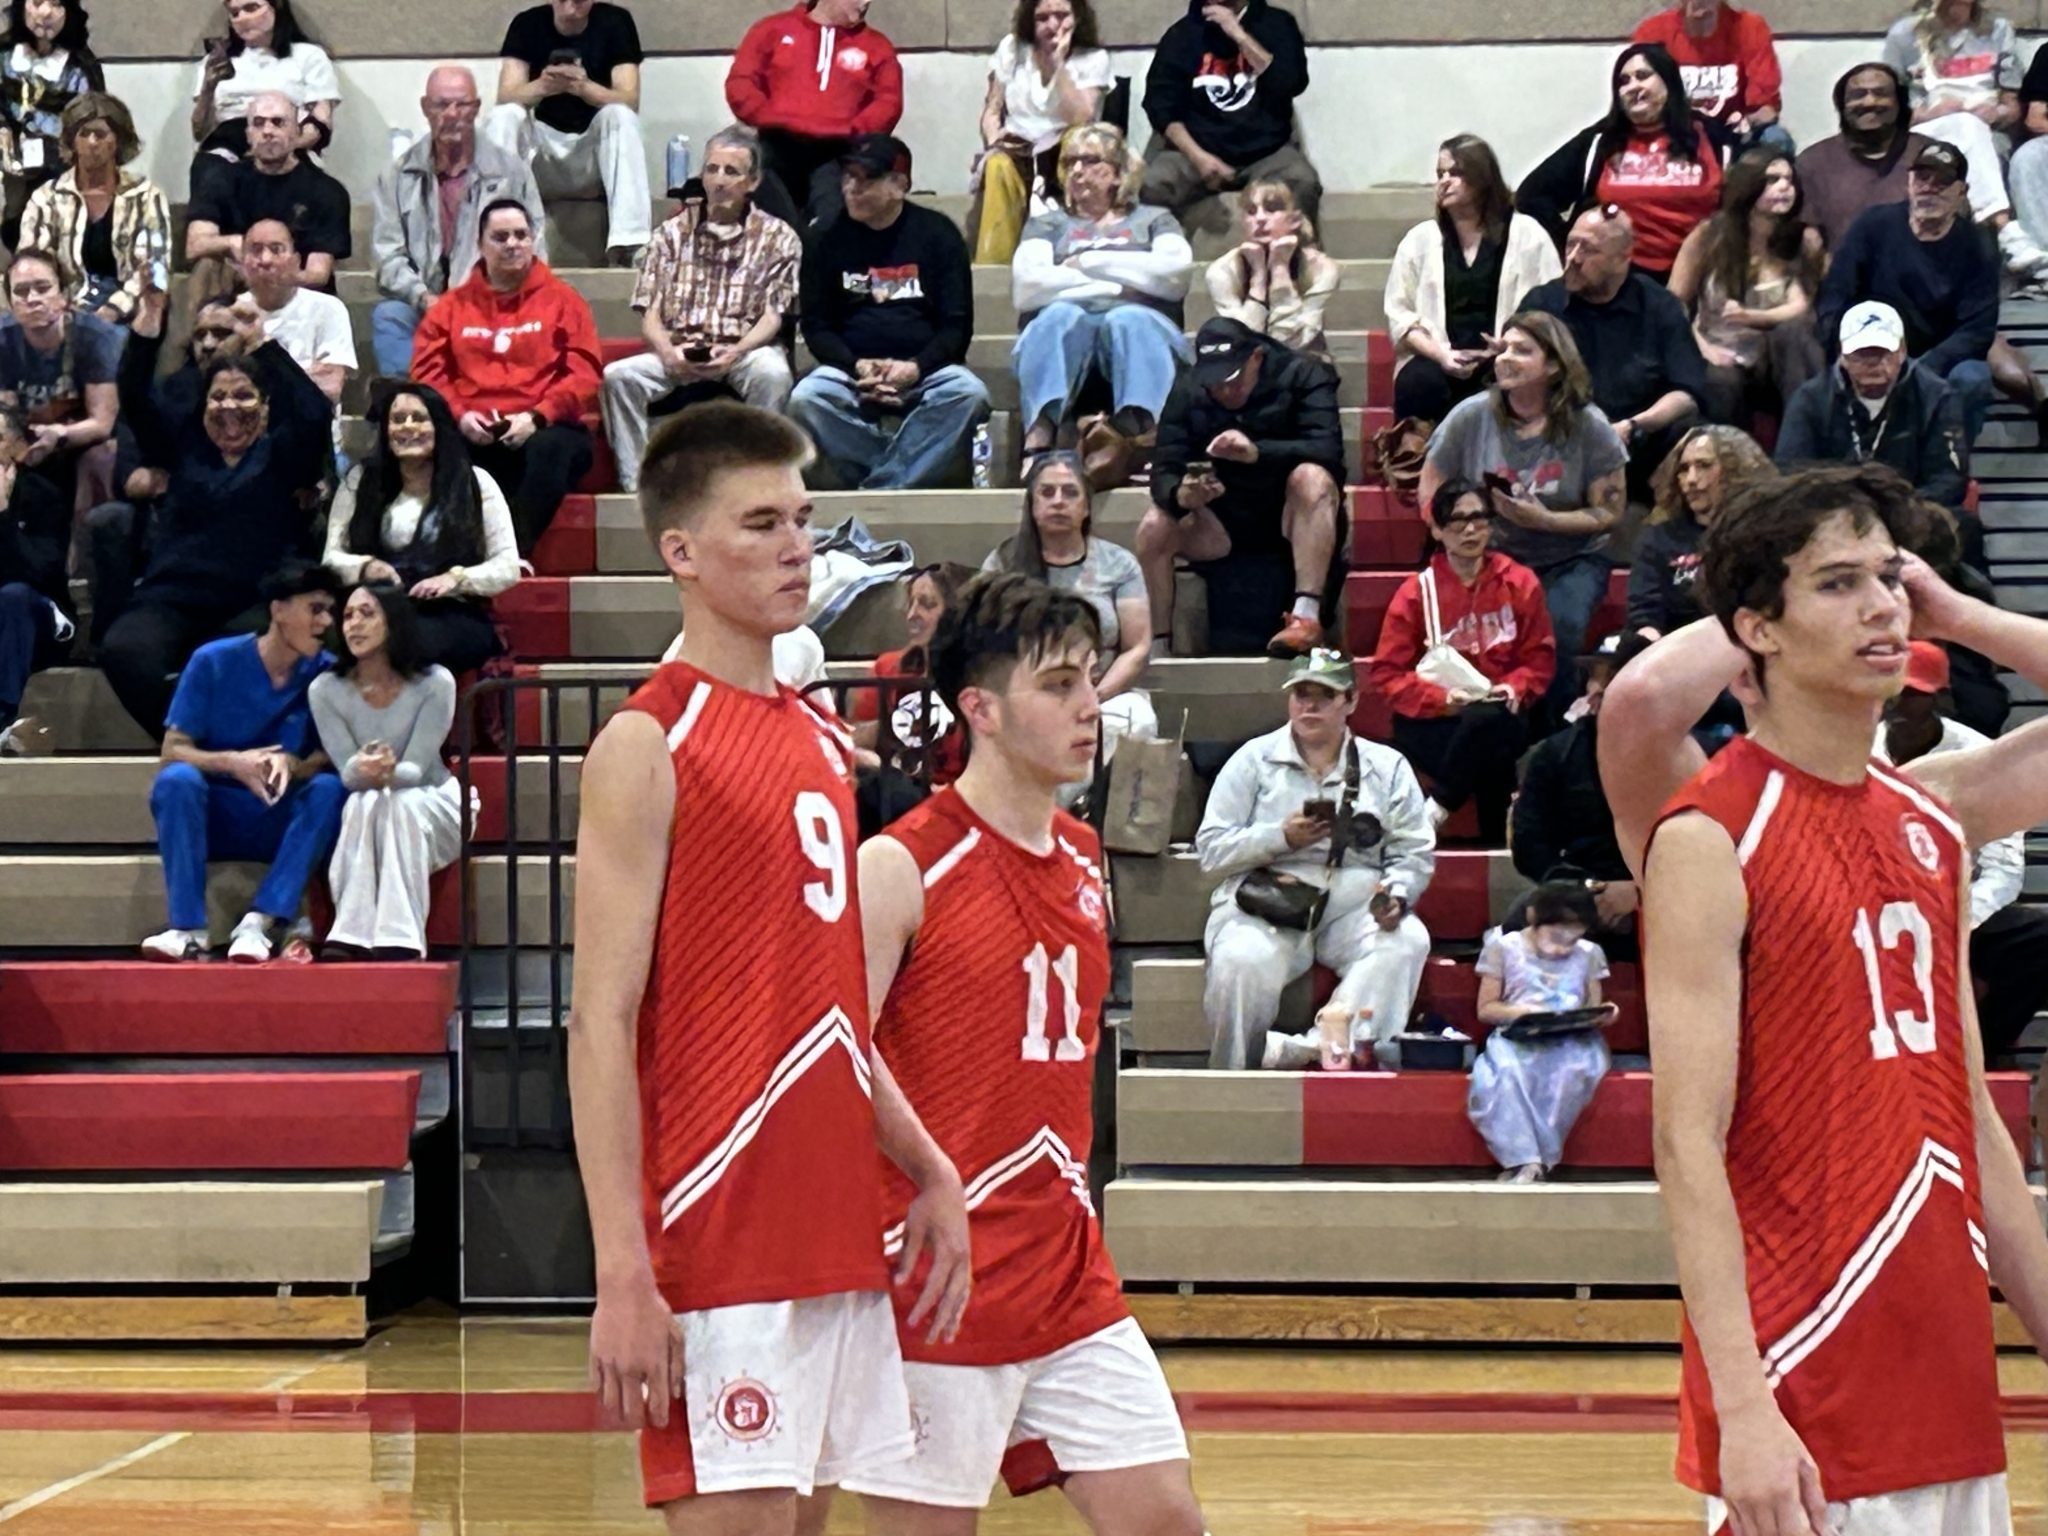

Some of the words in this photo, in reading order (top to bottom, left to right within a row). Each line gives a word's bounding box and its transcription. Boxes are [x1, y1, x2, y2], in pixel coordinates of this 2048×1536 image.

[794, 790, 848, 924] 9
[1021, 940, 1087, 1062] 11
[1851, 899, 1938, 1061] 13
